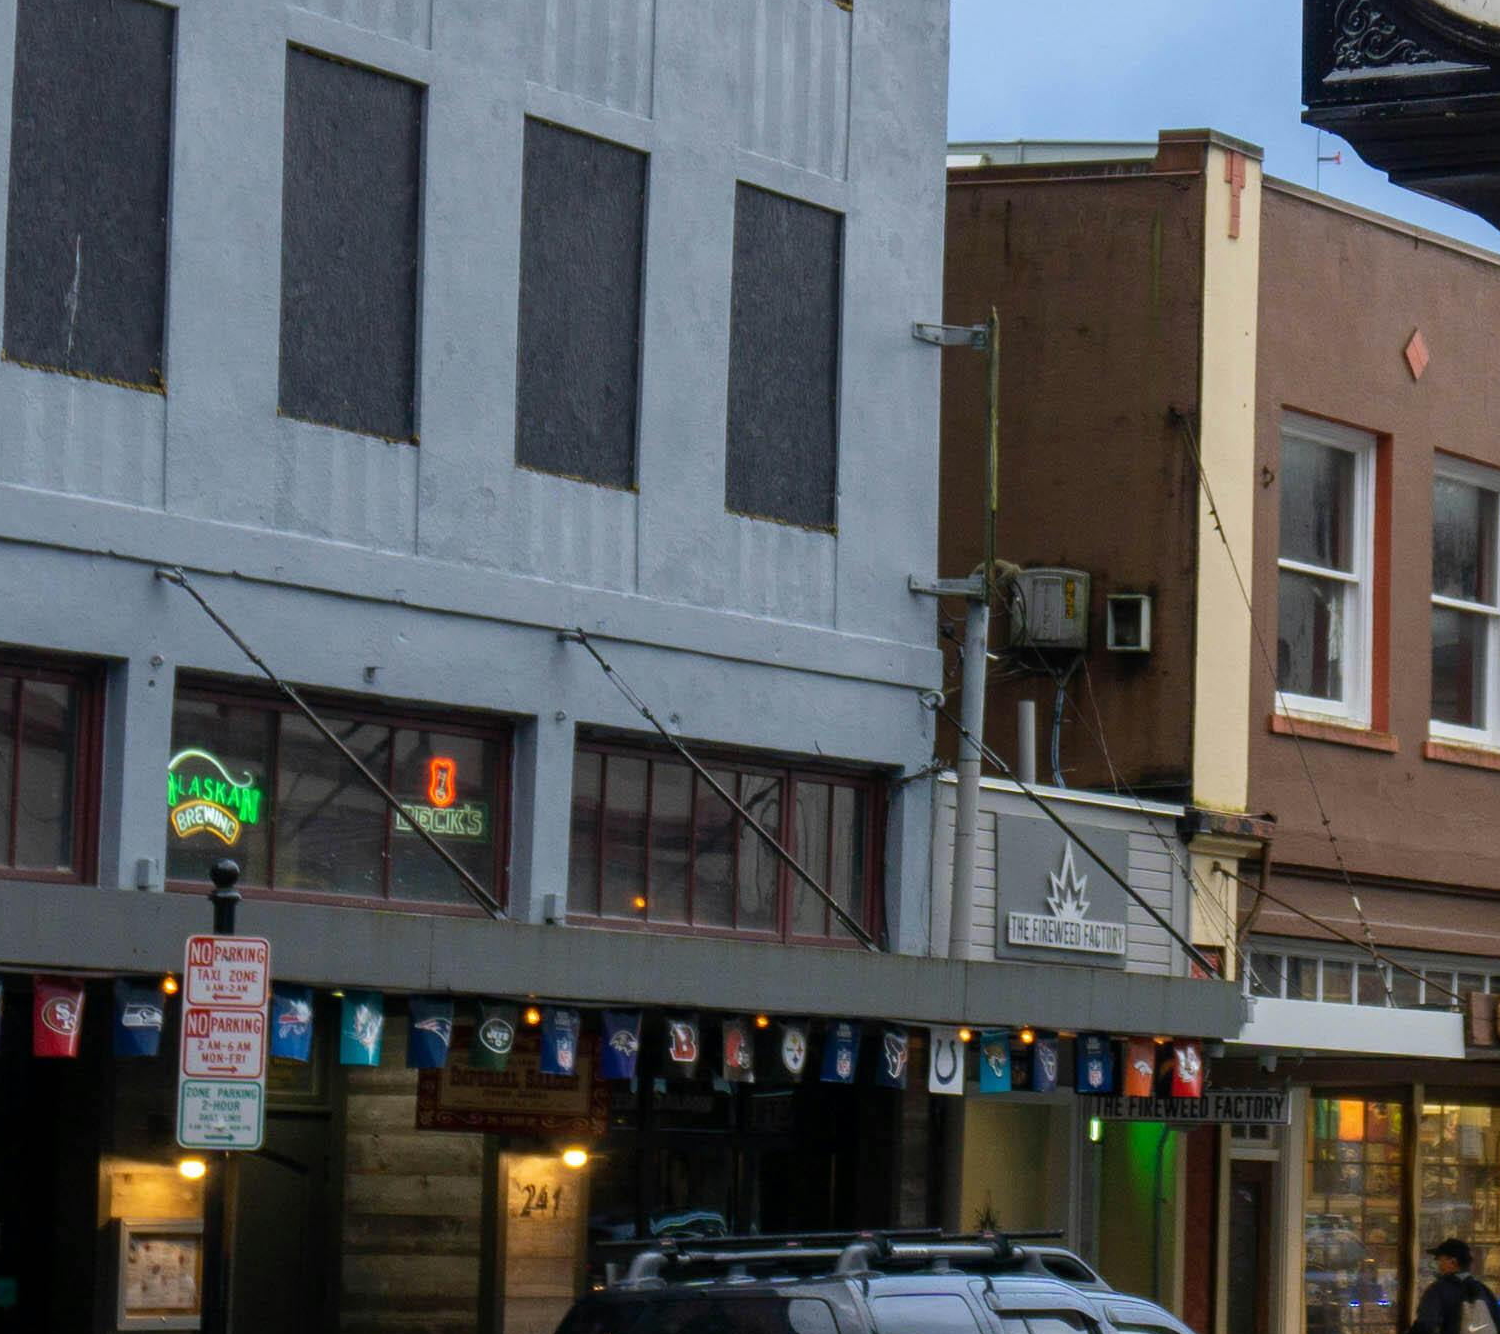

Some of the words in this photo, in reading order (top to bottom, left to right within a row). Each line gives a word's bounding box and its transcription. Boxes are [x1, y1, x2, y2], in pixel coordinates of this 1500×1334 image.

[177, 804, 237, 838] BREWING
[1012, 916, 1029, 941] THE
[1033, 919, 1081, 945] FIREWEED
[1084, 924, 1123, 950] FACTORY
[191, 942, 212, 964] NO
[215, 947, 264, 963] PARKING
[197, 969, 221, 981] TAXI
[229, 970, 258, 982] ZONE
[188, 1014, 210, 1035] NO
[211, 1017, 260, 1034] PARKING
[1096, 1096, 1122, 1118] THE
[1215, 1096, 1285, 1121] FACTORY
[520, 1183, 562, 1218] 241
